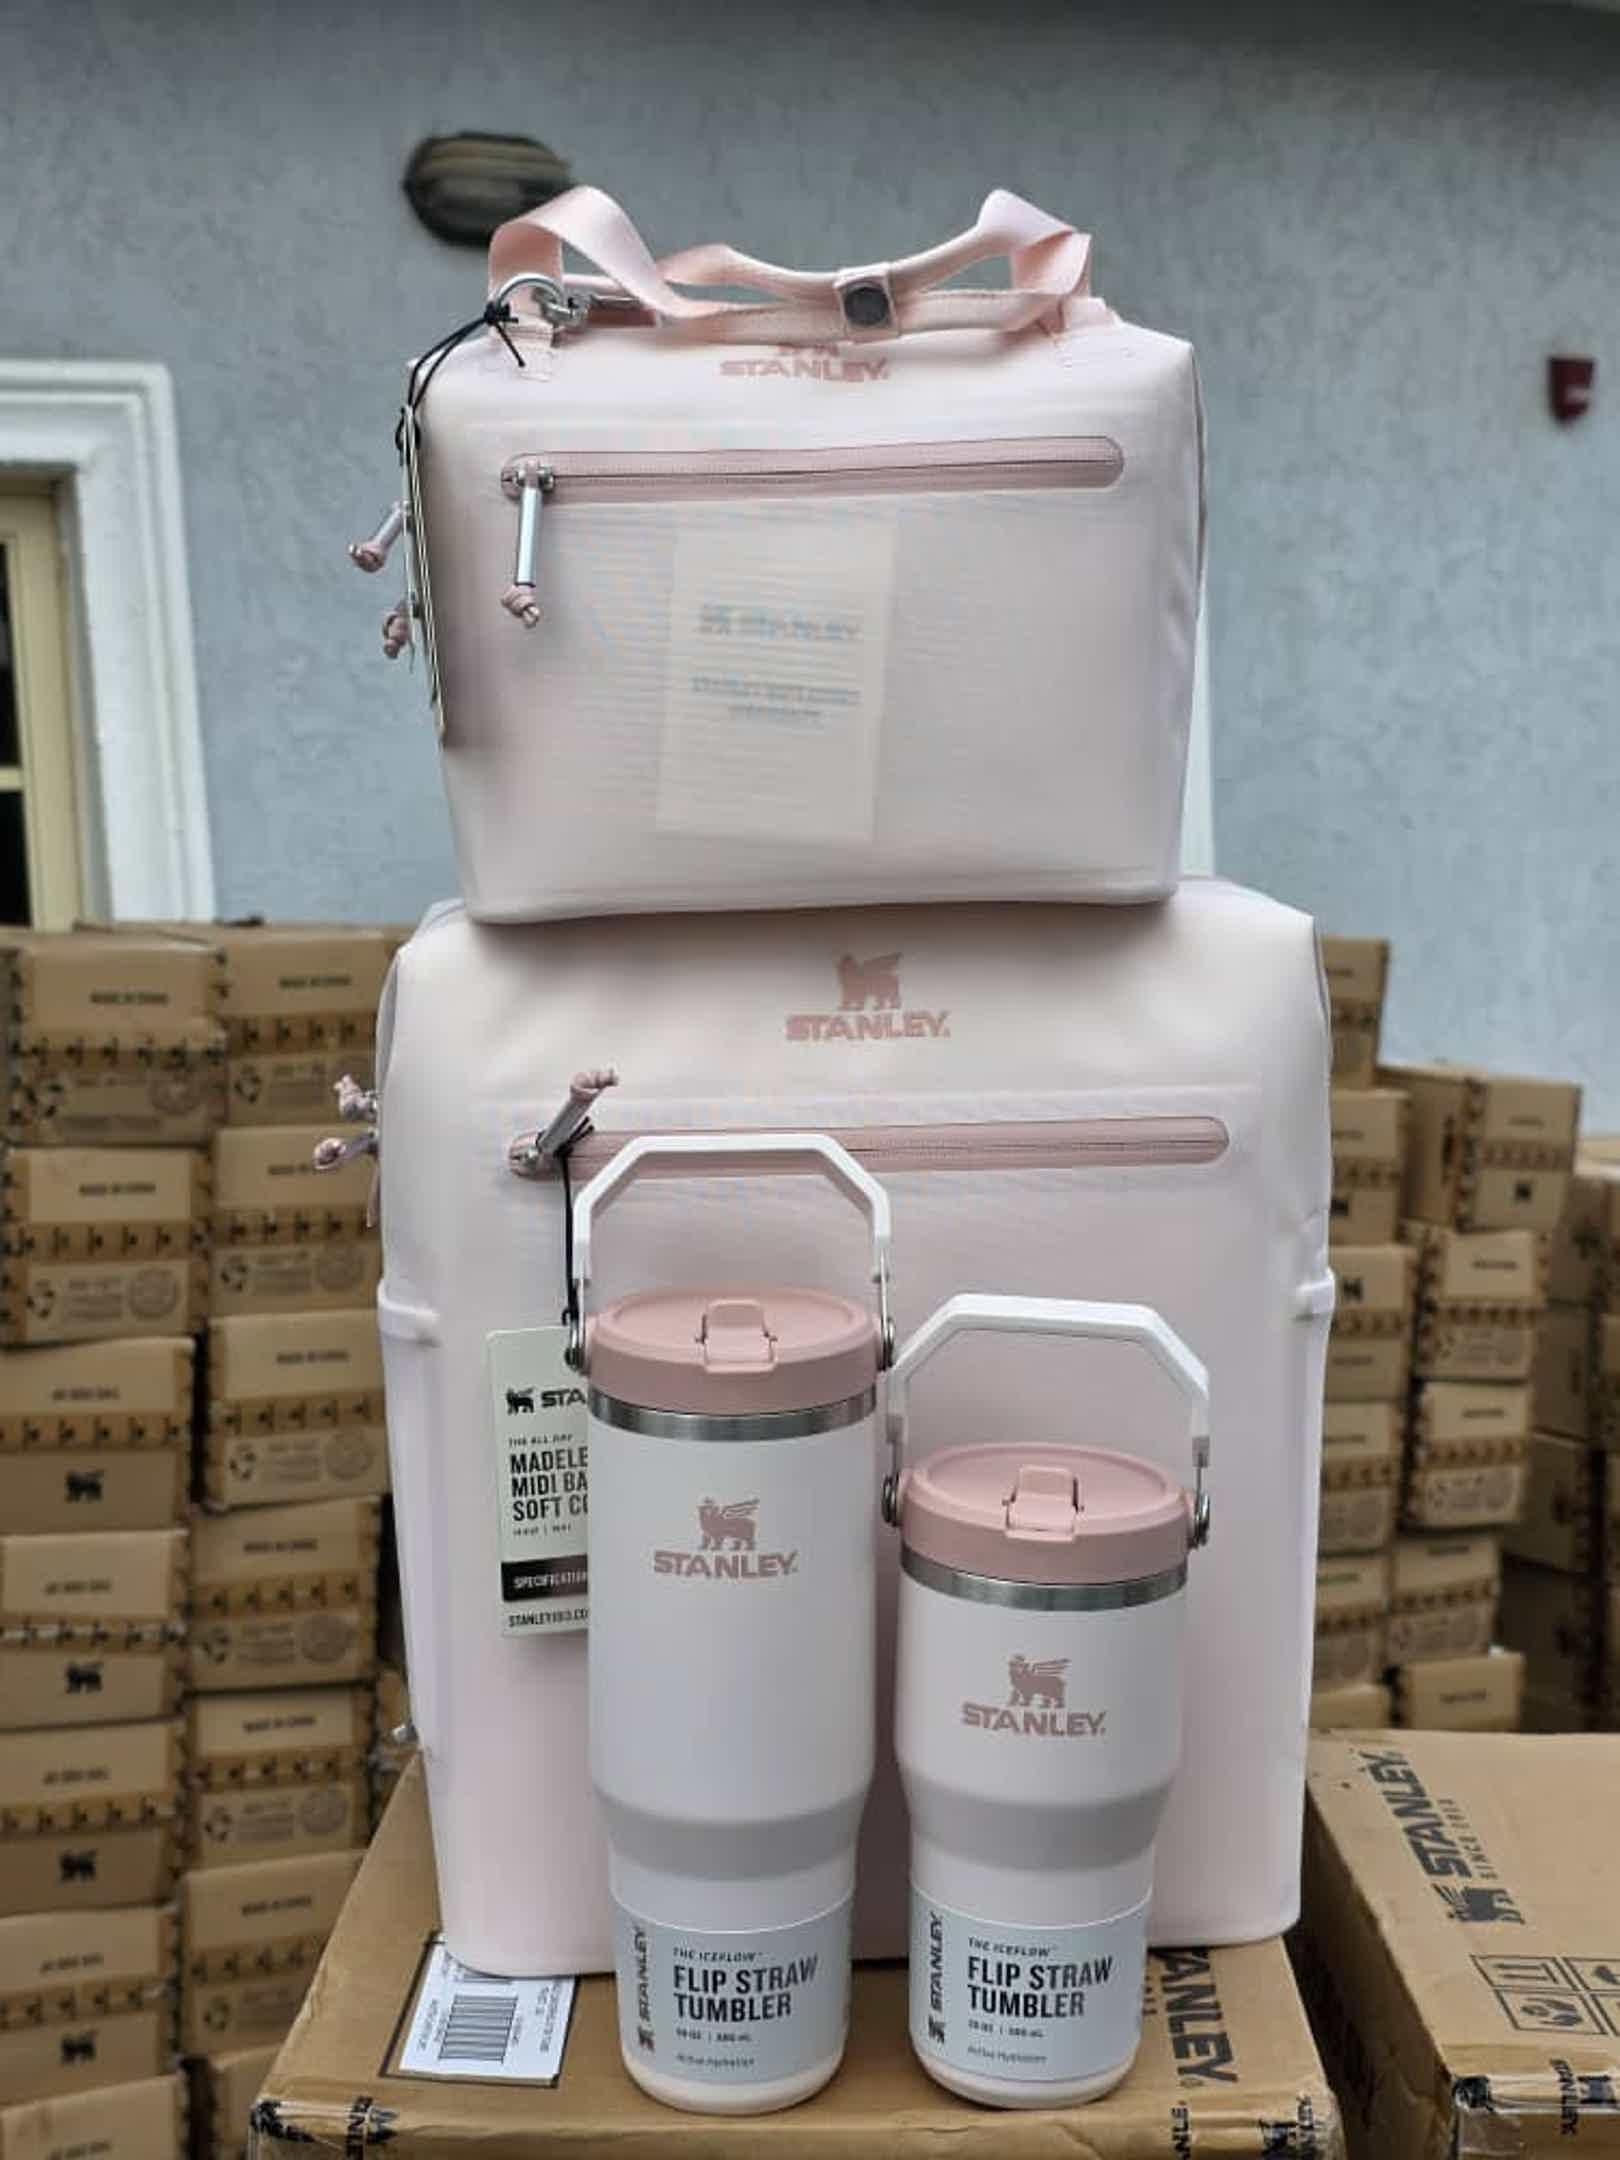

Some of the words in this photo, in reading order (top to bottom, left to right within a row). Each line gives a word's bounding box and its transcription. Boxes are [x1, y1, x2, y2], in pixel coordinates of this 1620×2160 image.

[719, 356, 889, 383] STANLEY
[785, 1010, 951, 1042] STANLEY
[511, 1473, 557, 1498] MIDI
[512, 1496, 562, 1521] SOFT
[654, 1549, 799, 1579] STANLEY
[962, 1701, 1106, 1736] STANLEY
[1358, 1749, 1473, 1879] STANLEY
[674, 1947, 695, 1960] THE
[968, 1936, 991, 1951] THE
[634, 1925, 651, 2022] STANLEY
[673, 1965, 727, 1995] FLIP
[735, 1953, 818, 1995] STRAW
[930, 1911, 943, 2013] STANLEY
[968, 1955, 1021, 1987] FLIP
[1029, 1955, 1113, 1990] STRAW
[673, 1992, 792, 2023] TUMBLER
[967, 1984, 1085, 2019] TUMBLER
[1160, 1948, 1239, 2083] ANLEY
